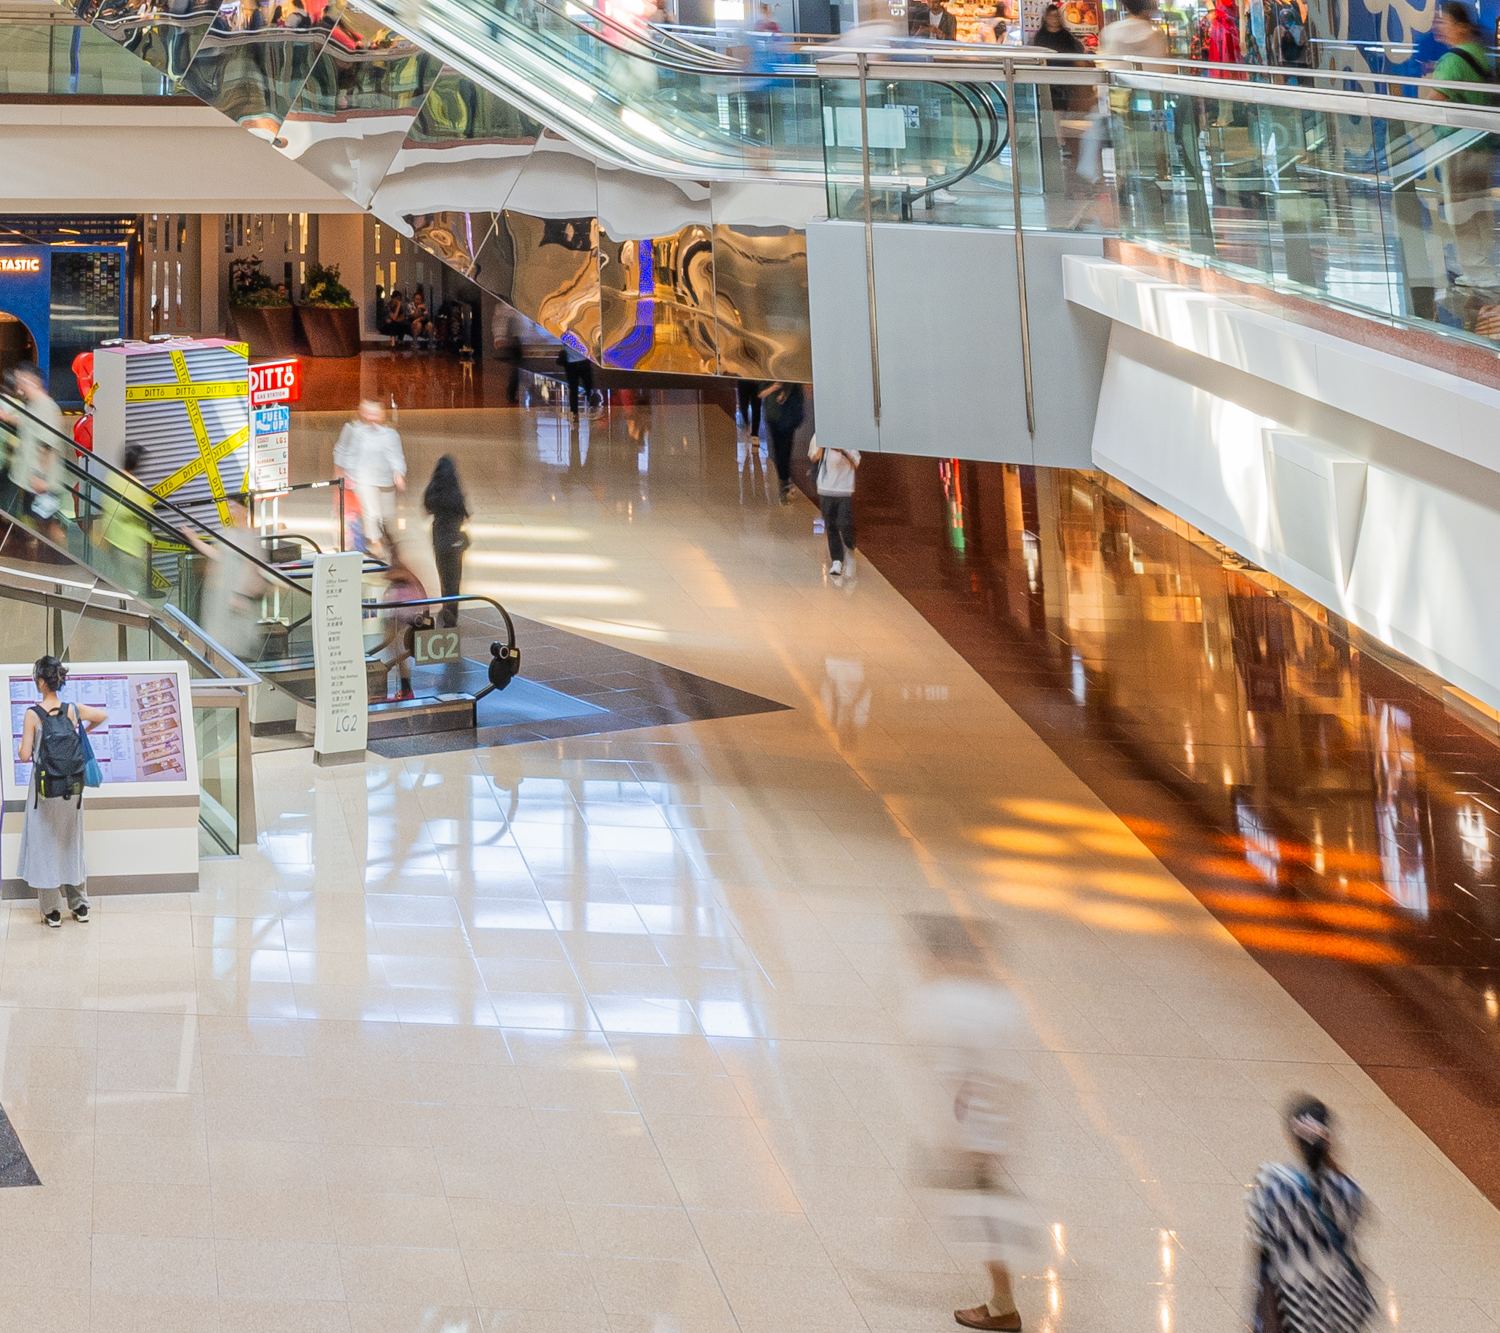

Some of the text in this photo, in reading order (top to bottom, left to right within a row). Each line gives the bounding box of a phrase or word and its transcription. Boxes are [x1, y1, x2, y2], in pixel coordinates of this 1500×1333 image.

[267, 391, 285, 399] STATION
[262, 410, 283, 421] FUEL
[272, 417, 289, 431] UP!
[416, 633, 459, 661] LG2
[336, 715, 358, 733] LG2
